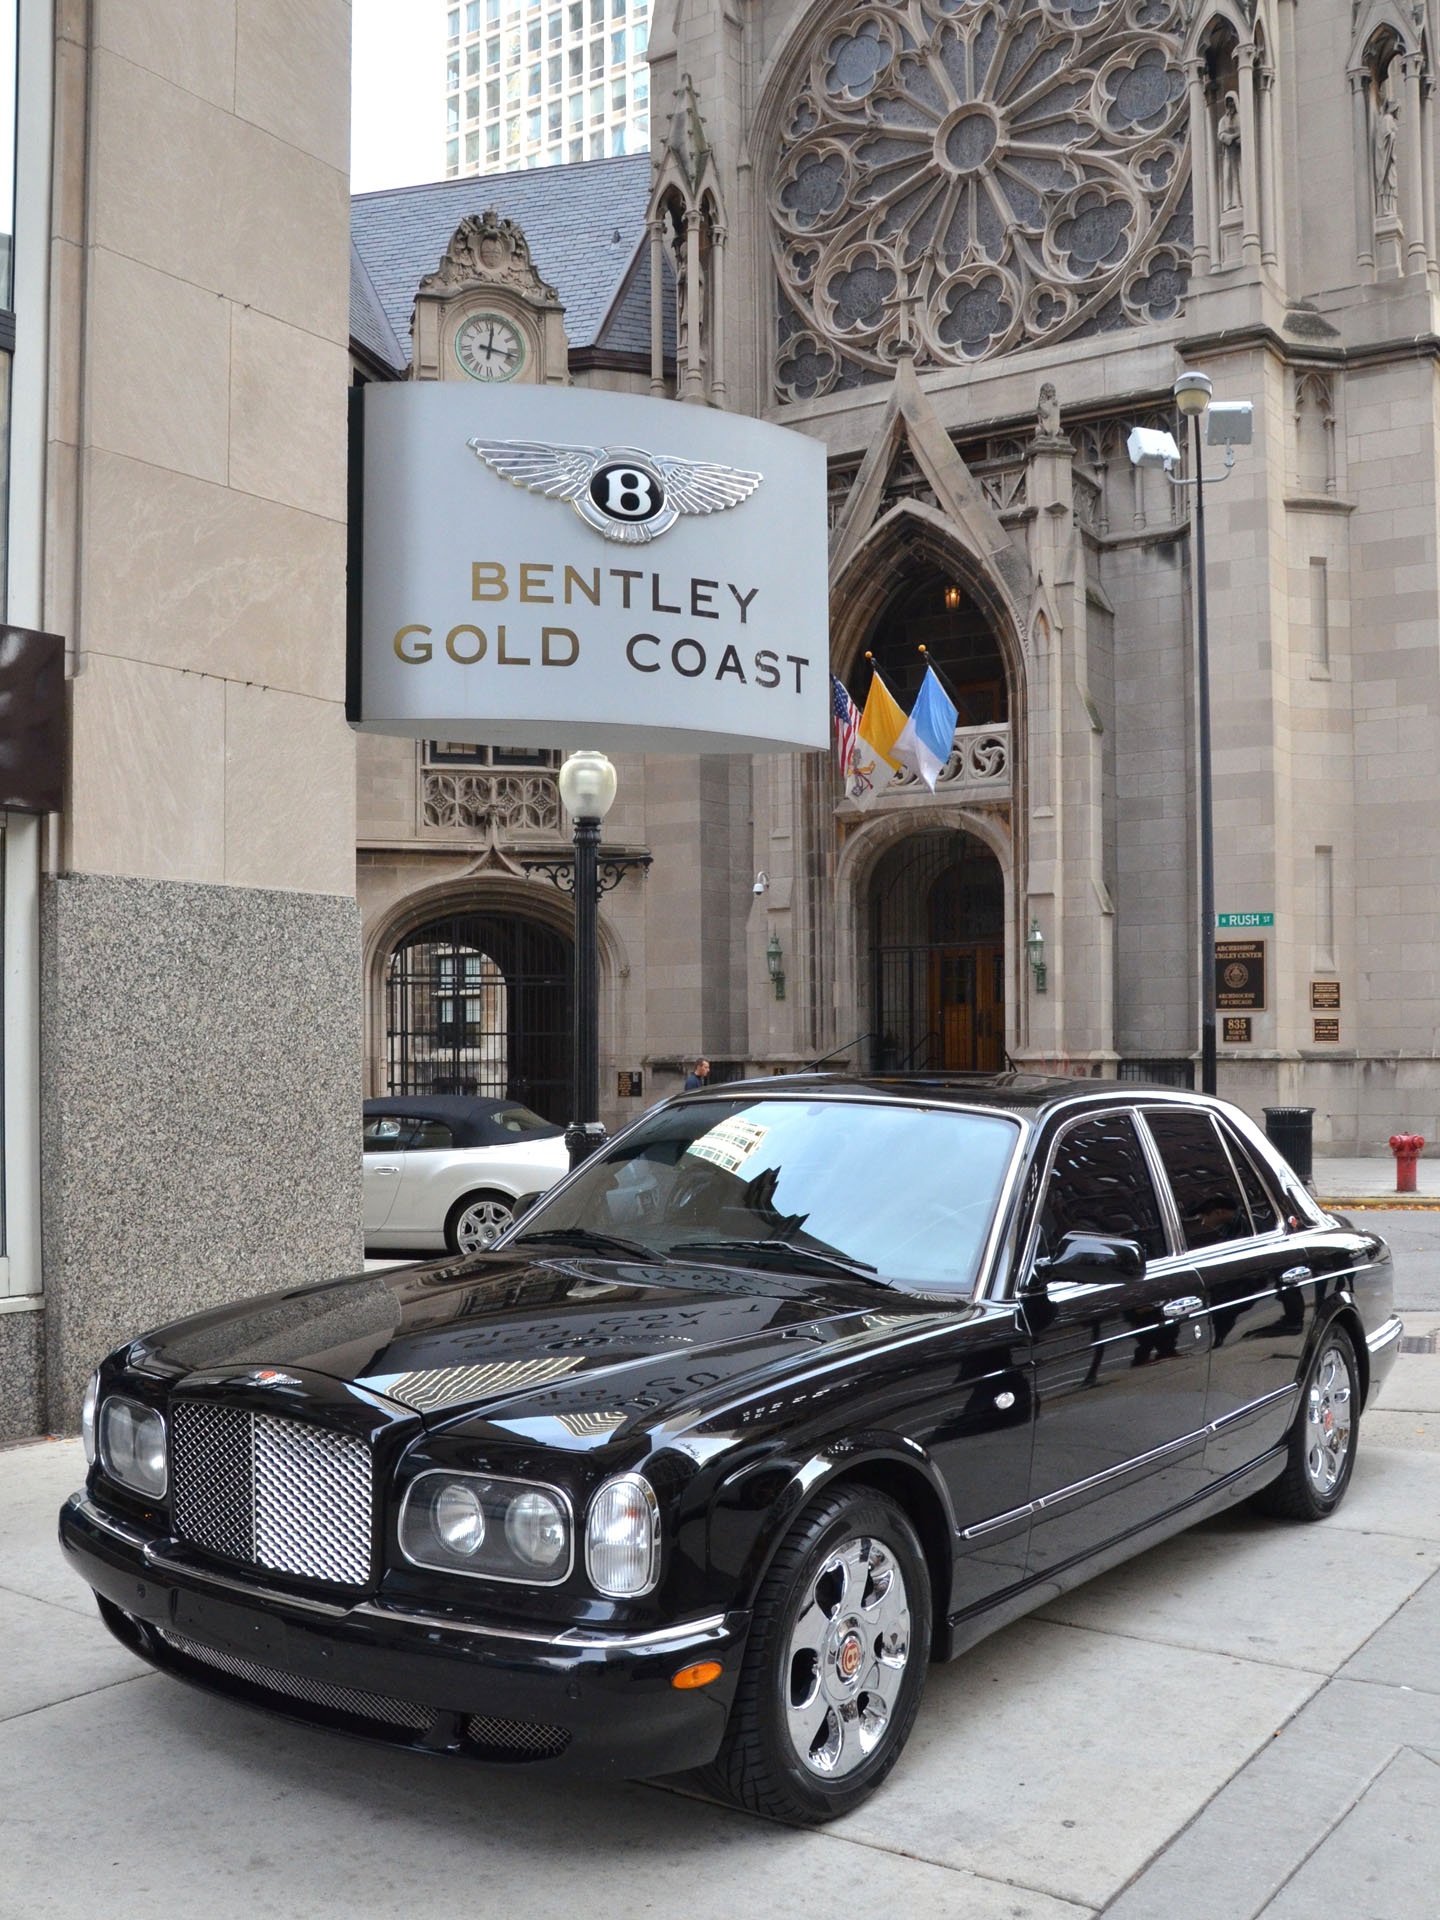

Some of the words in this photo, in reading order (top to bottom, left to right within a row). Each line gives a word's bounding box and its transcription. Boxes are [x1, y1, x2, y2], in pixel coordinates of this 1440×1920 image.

[606, 469, 651, 516] B
[471, 561, 759, 624] BENTLEY
[393, 624, 580, 667] GOLD
[625, 632, 809, 695] COAST
[1229, 914, 1260, 926] RUSH
[1263, 915, 1271, 923] ST
[1228, 1019, 1247, 1030] 835
